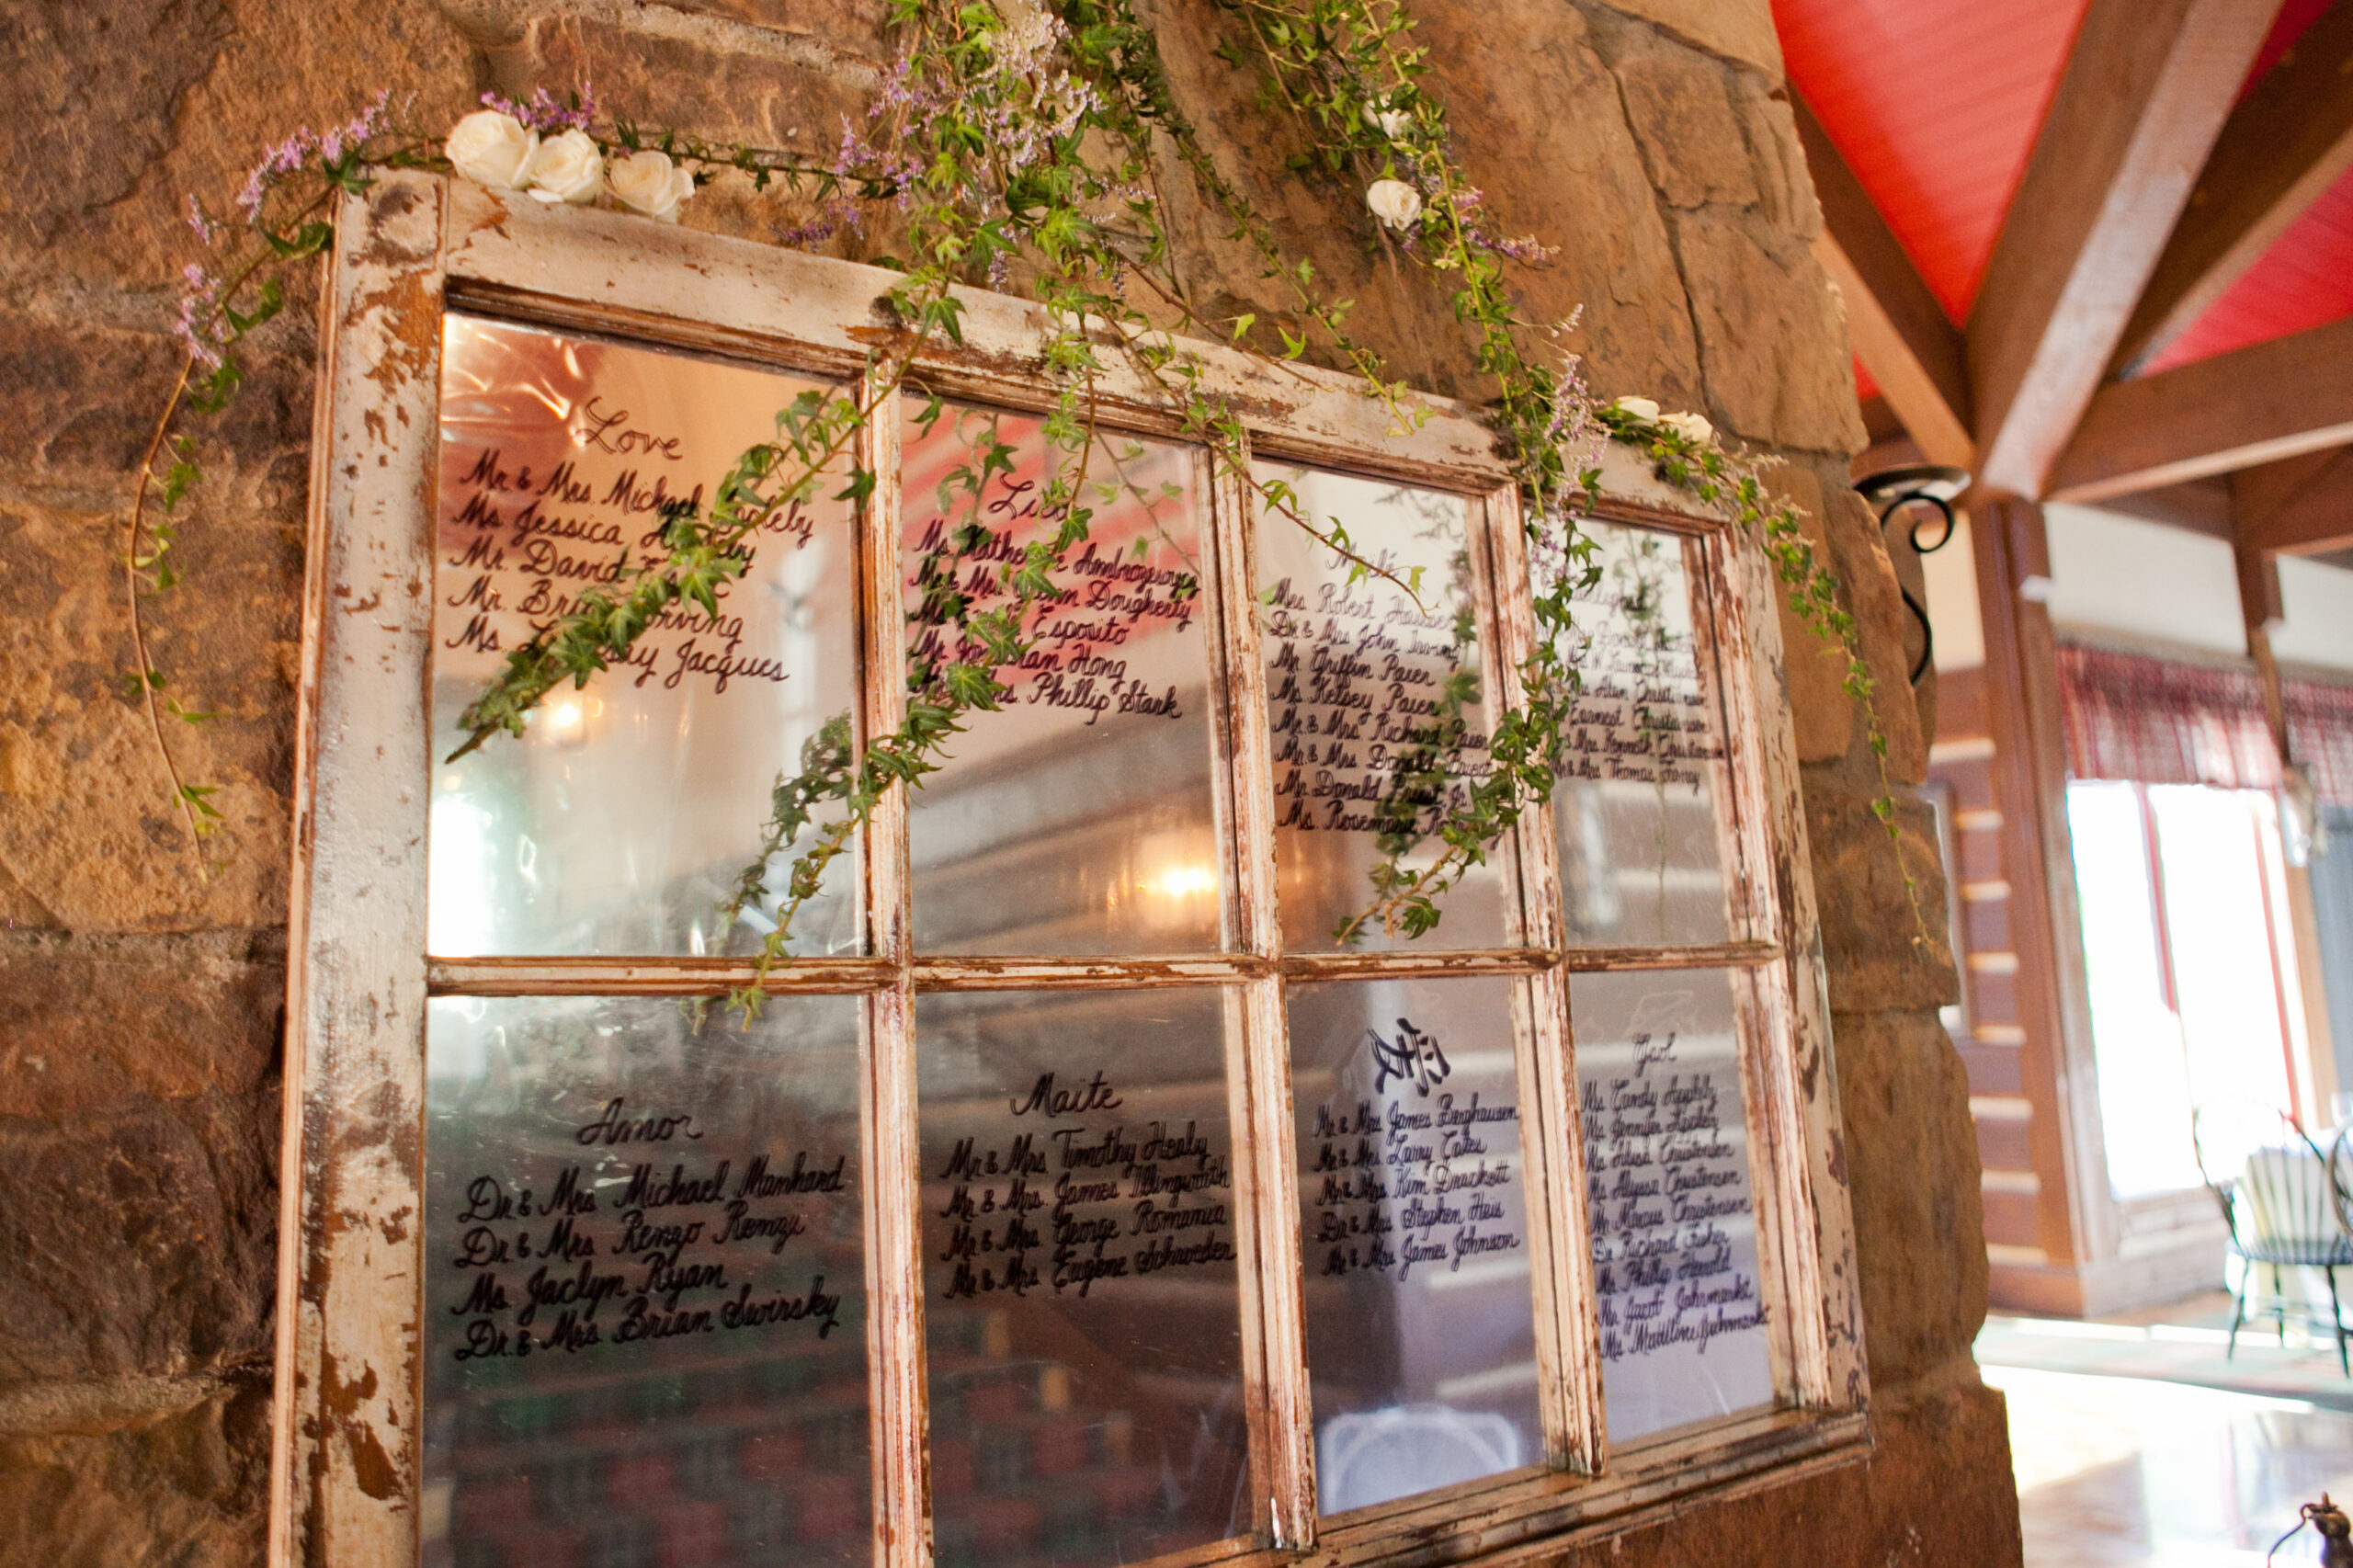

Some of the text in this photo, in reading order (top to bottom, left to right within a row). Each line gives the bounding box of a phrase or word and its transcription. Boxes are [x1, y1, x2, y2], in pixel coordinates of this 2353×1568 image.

[576, 396, 682, 460] Love
[511, 498, 625, 547] Jessica
[519, 539, 627, 584] David
[1086, 580, 1193, 633] Dougherty
[1318, 583, 1376, 619] Robert
[1031, 604, 1131, 649] Esposito
[1358, 624, 1401, 658] John
[664, 637, 790, 694] Jacques
[1067, 643, 1127, 696] Hong
[1311, 643, 1374, 691] Griffin
[1027, 671, 1183, 725] Phillip Stark
[1309, 678, 1376, 728] Kelsey
[1313, 769, 1383, 803] Donald
[1010, 1071, 1123, 1118] Maite
[576, 1096, 704, 1145] Amor
[1386, 1100, 1433, 1146] James
[1386, 1133, 1435, 1176] Larry
[612, 1159, 726, 1209] Michael
[1052, 1171, 1120, 1221] James
[1392, 1166, 1431, 1199] Kim
[1052, 1210, 1120, 1258] George
[1401, 1196, 1465, 1242] Stephen
[1398, 1233, 1449, 1282] James
[1450, 1225, 1520, 1272] Johnson
[635, 1251, 728, 1312] Ryan
[611, 1296, 715, 1344] Brian
